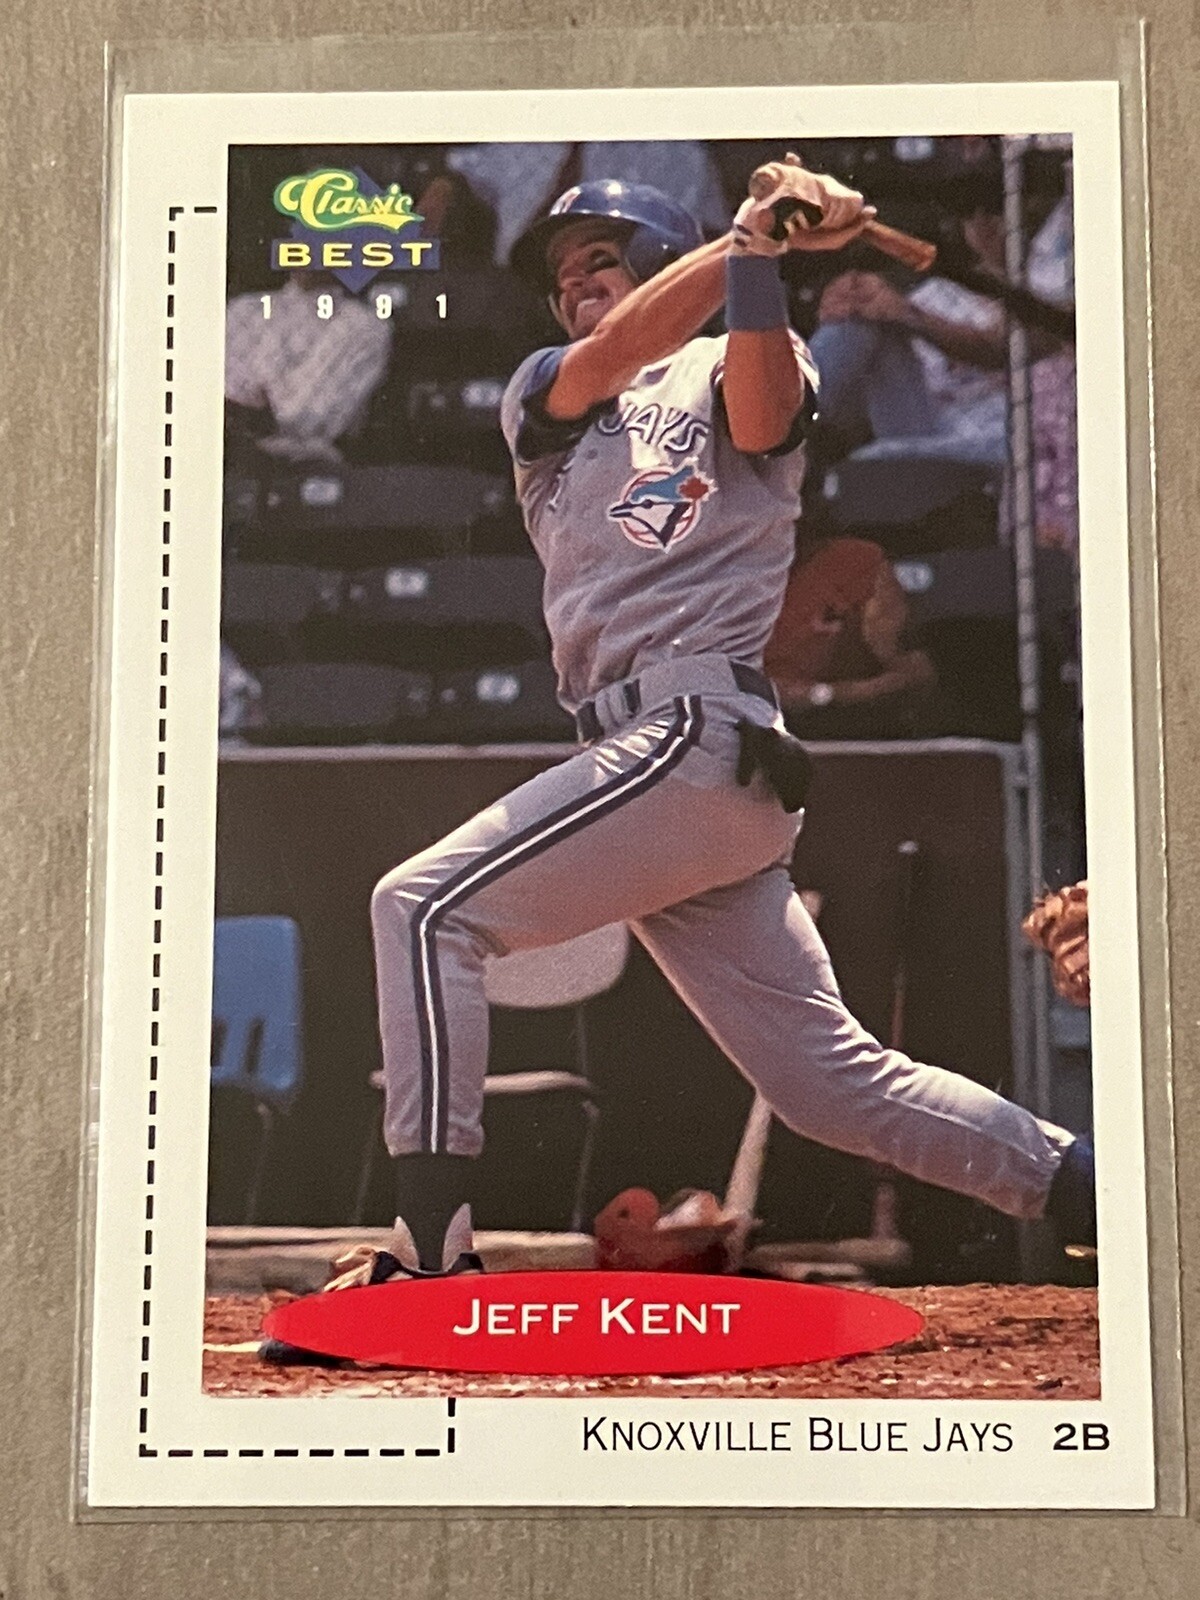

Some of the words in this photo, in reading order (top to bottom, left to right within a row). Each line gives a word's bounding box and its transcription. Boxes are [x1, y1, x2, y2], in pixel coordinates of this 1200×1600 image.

[275, 169, 424, 232] Classic
[278, 242, 433, 267] BEST
[260, 294, 448, 320] 1991
[452, 1298, 580, 1336] JEFF
[600, 1297, 742, 1336] KENT
[583, 1416, 793, 1452] KNOXVILLE
[808, 1417, 909, 1452] BLUE
[923, 1417, 1014, 1453] JAYS
[1053, 1423, 1111, 1451] 2B
